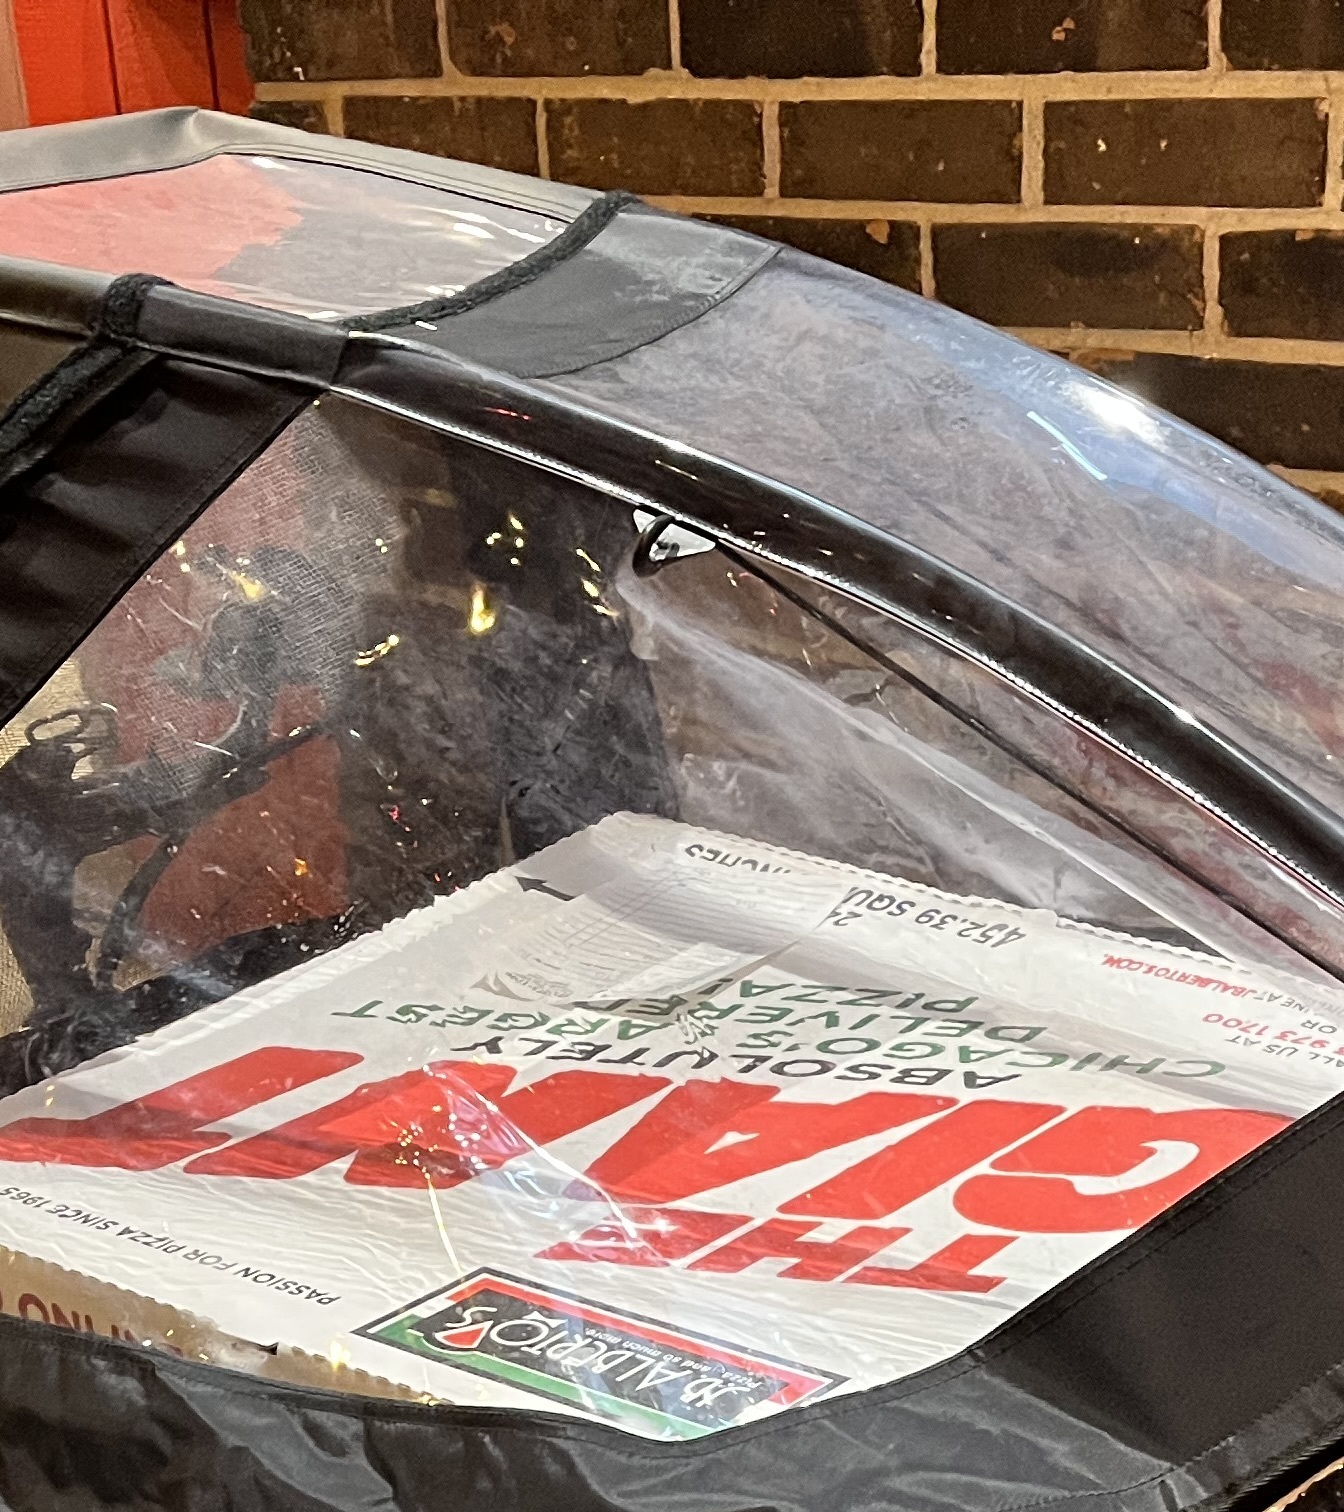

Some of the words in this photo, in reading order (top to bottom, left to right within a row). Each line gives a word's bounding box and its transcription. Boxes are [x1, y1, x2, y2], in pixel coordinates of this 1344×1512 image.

[841, 887, 917, 919] SQU
[915, 908, 1026, 949] 452.39
[697, 977, 980, 1015] PIZZA!
[330, 999, 716, 1046] ARGEST
[1201, 1012, 1270, 1037] 1700
[1300, 1019, 1338, 1035] OR
[733, 1030, 1226, 1078] CHICAGO'S
[1223, 1034, 1261, 1048] AT
[1264, 1043, 1299, 1058] US
[1278, 1030, 1330, 1050] 973
[450, 1036, 1022, 1091] ABSOLUTELY
[46, 1203, 120, 1232] SINCE
[116, 1225, 188, 1255] PIZZA
[531, 1205, 1008, 1294] THE
[183, 1248, 239, 1272] FOR
[234, 1266, 342, 1306] PASSION
[622, 1340, 662, 1357] much
[662, 1353, 683, 1364] so
[681, 1358, 712, 1373] and
